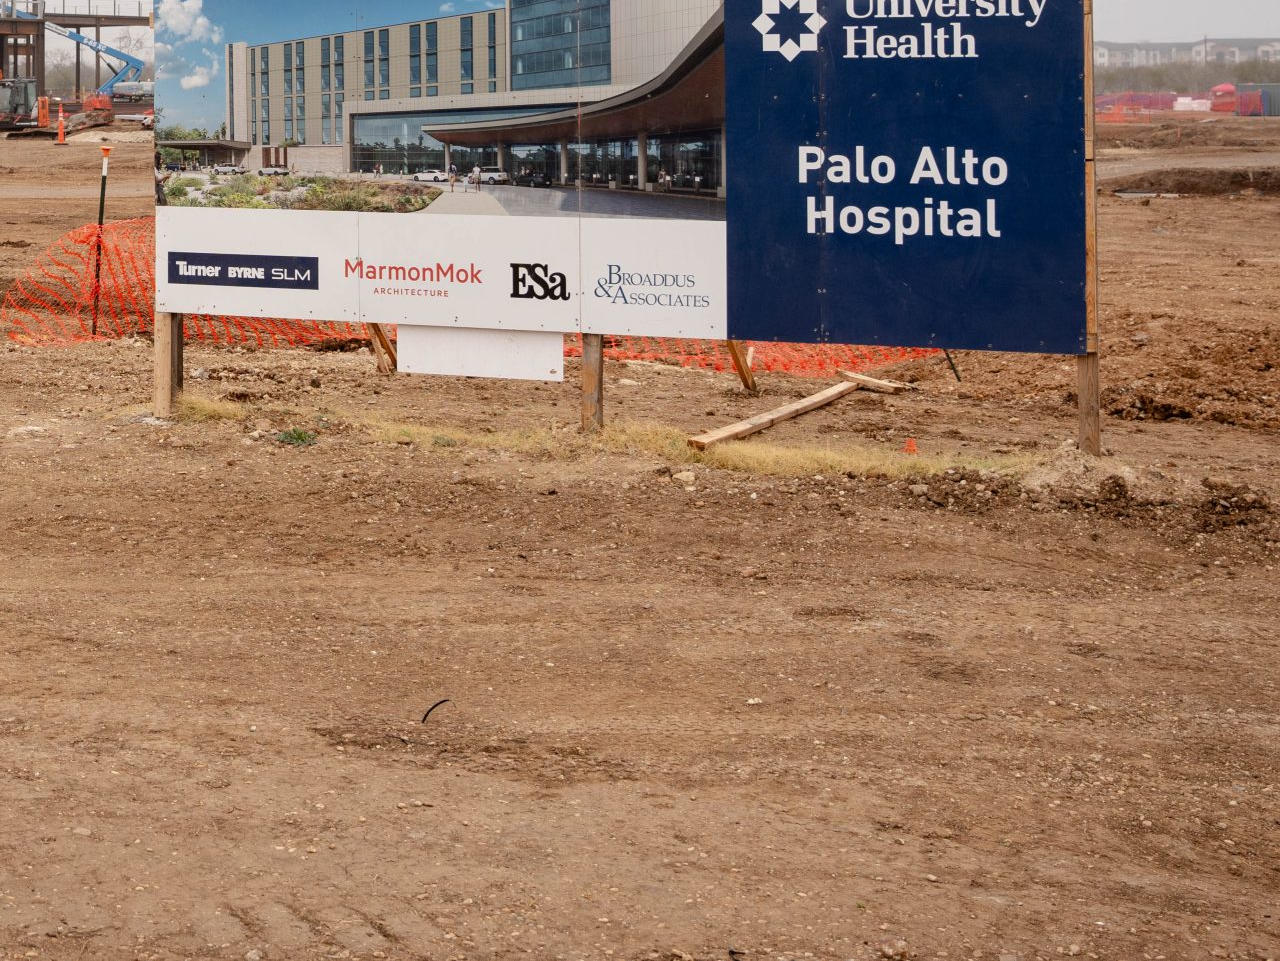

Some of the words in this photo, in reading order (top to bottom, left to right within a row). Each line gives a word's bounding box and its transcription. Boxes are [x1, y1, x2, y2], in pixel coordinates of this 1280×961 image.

[842, 22, 979, 59] Health
[798, 145, 896, 184] Palo
[909, 146, 1008, 186] Alto
[806, 195, 1001, 245] Hospital
[175, 260, 222, 277] Turner
[227, 266, 265, 279] BYRNE
[271, 268, 311, 281] SLM
[344, 258, 483, 284] MarmonMok
[509, 262, 571, 301] ESa
[607, 264, 696, 288] BROADDUS
[373, 287, 449, 298] ARCHITECTURE
